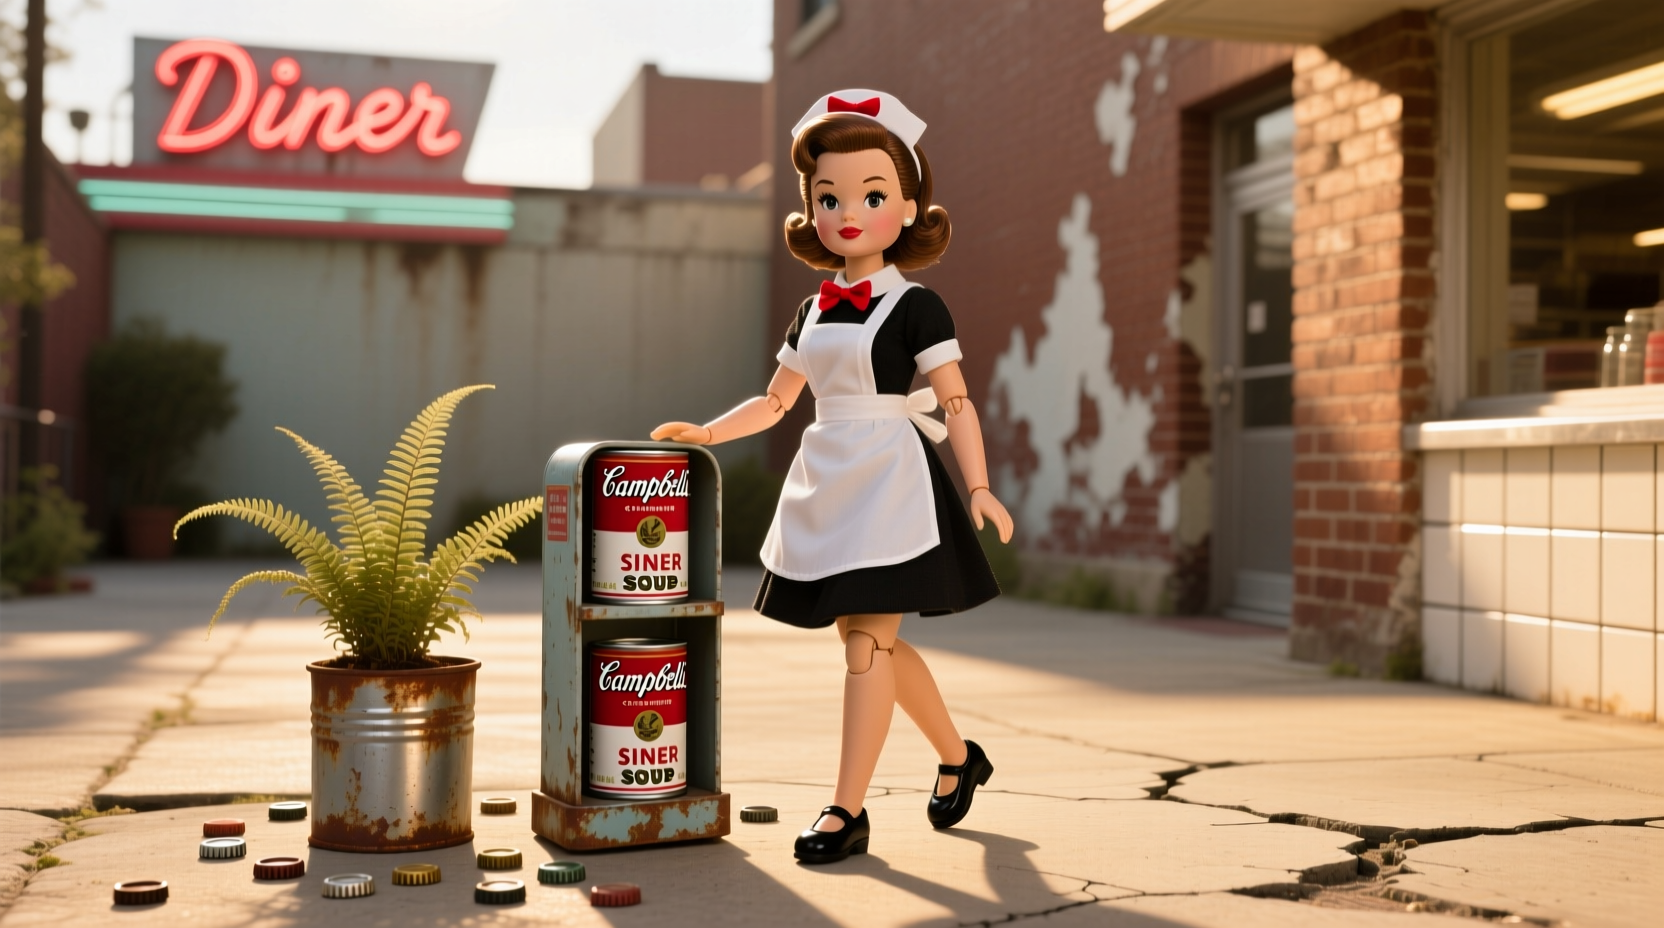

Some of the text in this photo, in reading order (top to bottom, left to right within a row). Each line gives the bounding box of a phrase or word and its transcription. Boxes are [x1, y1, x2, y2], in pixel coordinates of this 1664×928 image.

[155, 38, 462, 156] Diner
[620, 553, 682, 571] SINER
[622, 575, 678, 591] SOUP
[618, 745, 678, 766] SINER
[621, 768, 675, 785] SOUP
